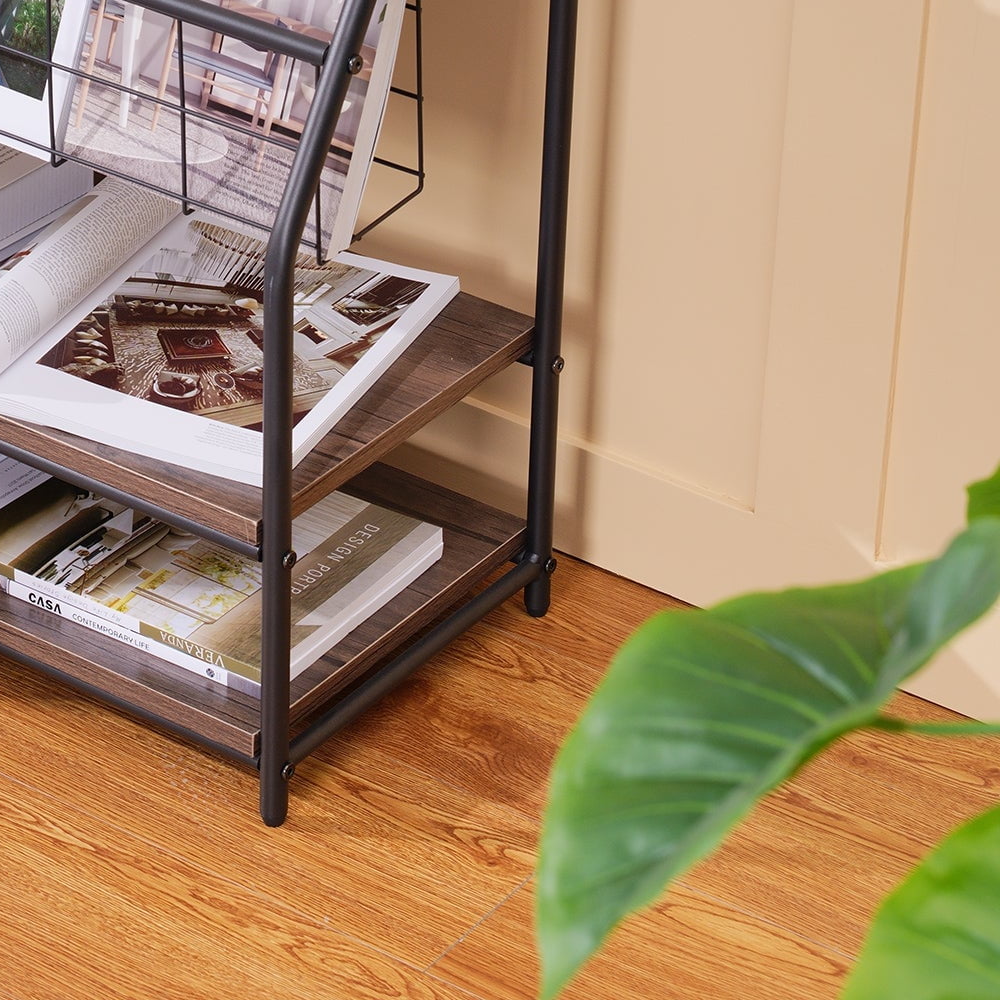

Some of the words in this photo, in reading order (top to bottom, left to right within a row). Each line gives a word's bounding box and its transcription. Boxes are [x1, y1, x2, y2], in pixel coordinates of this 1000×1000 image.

[327, 523, 381, 564] DESIGN
[28, 592, 63, 615] CASA
[72, 613, 134, 643] CONTEMPORARY
[134, 638, 151, 651] LIFE
[159, 630, 226, 669] VERANDA
